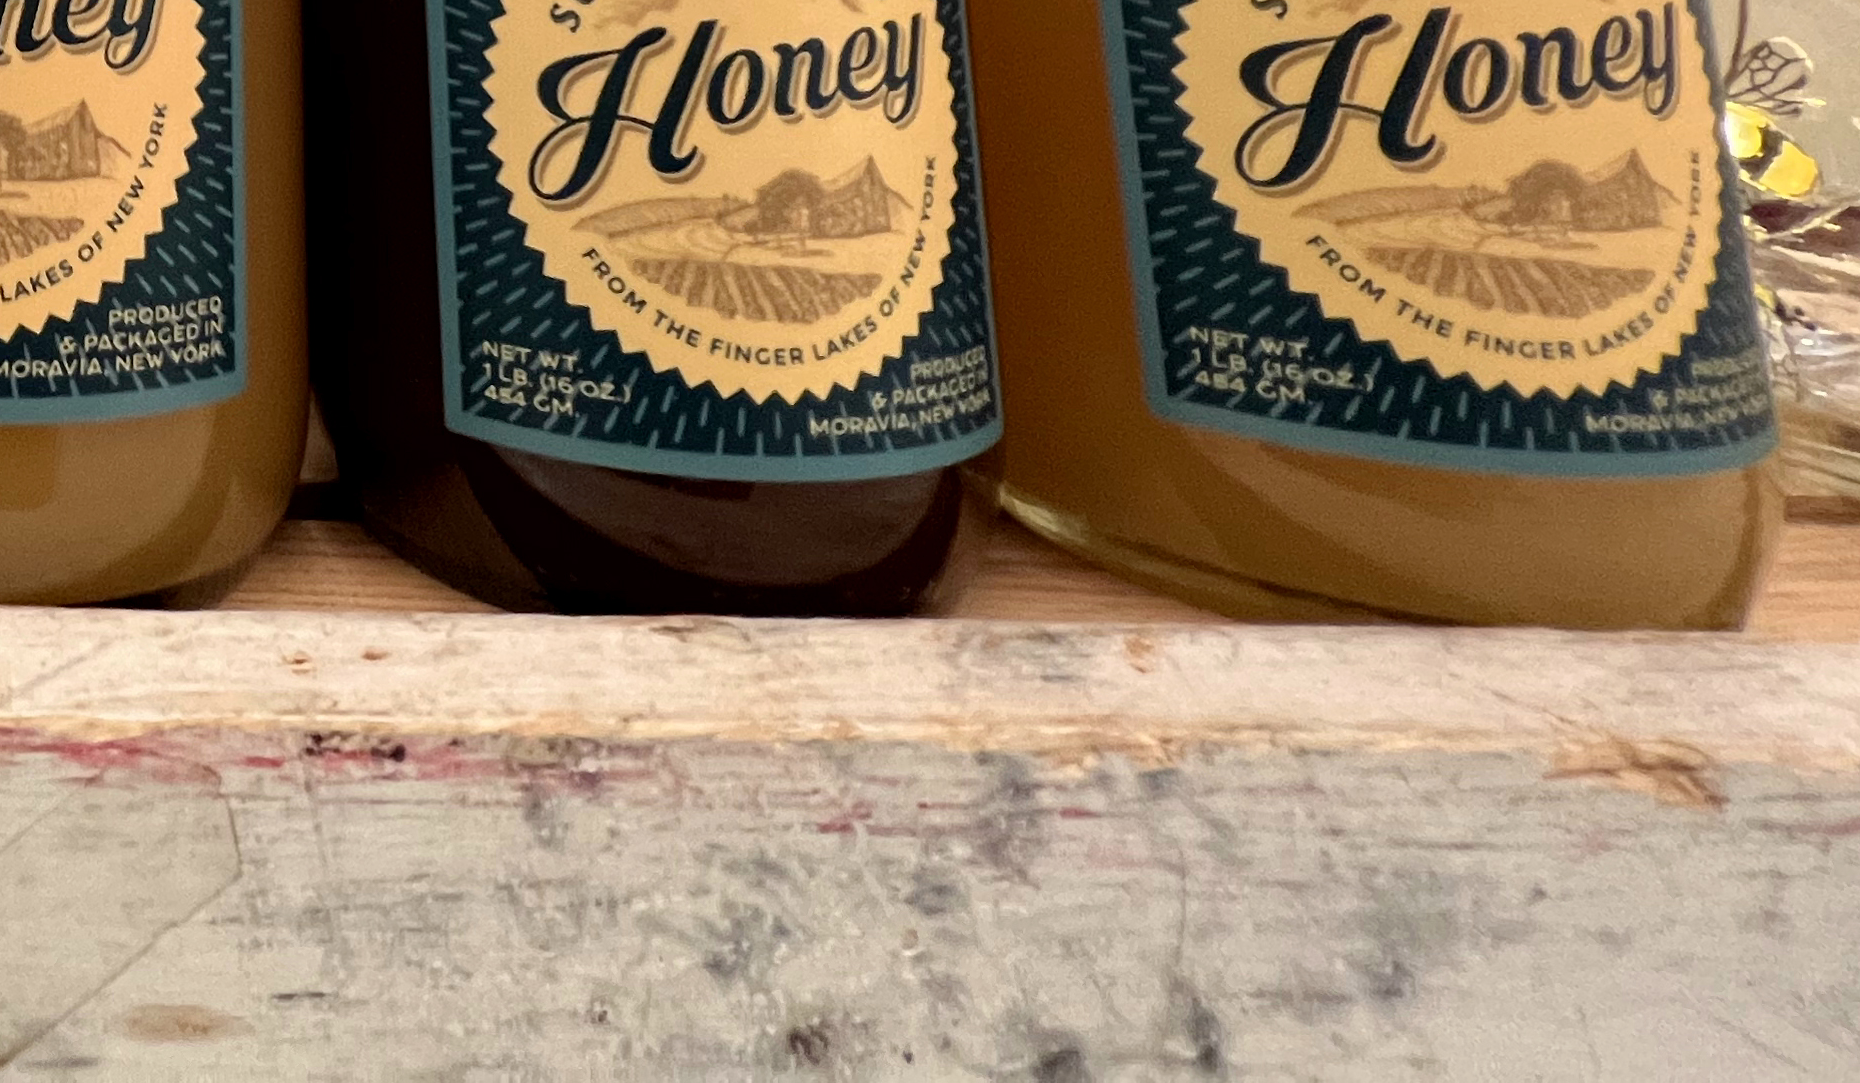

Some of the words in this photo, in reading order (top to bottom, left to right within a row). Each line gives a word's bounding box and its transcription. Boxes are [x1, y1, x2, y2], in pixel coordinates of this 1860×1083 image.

[527, 13, 924, 206] Honey
[1234, 1, 1680, 192] Honey
[0, 259, 74, 303] LAKES
[77, 231, 105, 263] OF
[106, 175, 144, 232] NEW
[139, 102, 167, 169] YORK
[582, 247, 647, 314] FROM
[652, 309, 701, 348] THE
[709, 338, 804, 366] FINGER
[812, 314, 878, 360] LAKES
[879, 286, 900, 317] OF
[900, 228, 927, 287] NEW
[921, 157, 936, 220] YORK
[109, 295, 222, 327] PRODUCED
[1305, 235, 1387, 303] FROM
[1397, 298, 1455, 339] THE
[1464, 329, 1576, 360] FINGER
[1583, 312, 1654, 357] LAKES
[1655, 283, 1676, 313] OF
[59, 336, 78, 354] &
[84, 323, 198, 353] PACKAGED
[204, 319, 223, 336] IN
[482, 340, 531, 363] NET
[1190, 326, 1249, 349] NET
[115, 349, 164, 373] NEW
[171, 340, 225, 364] YORK
[809, 413, 917, 437] MORAVIA,
[919, 404, 955, 425] NEW
